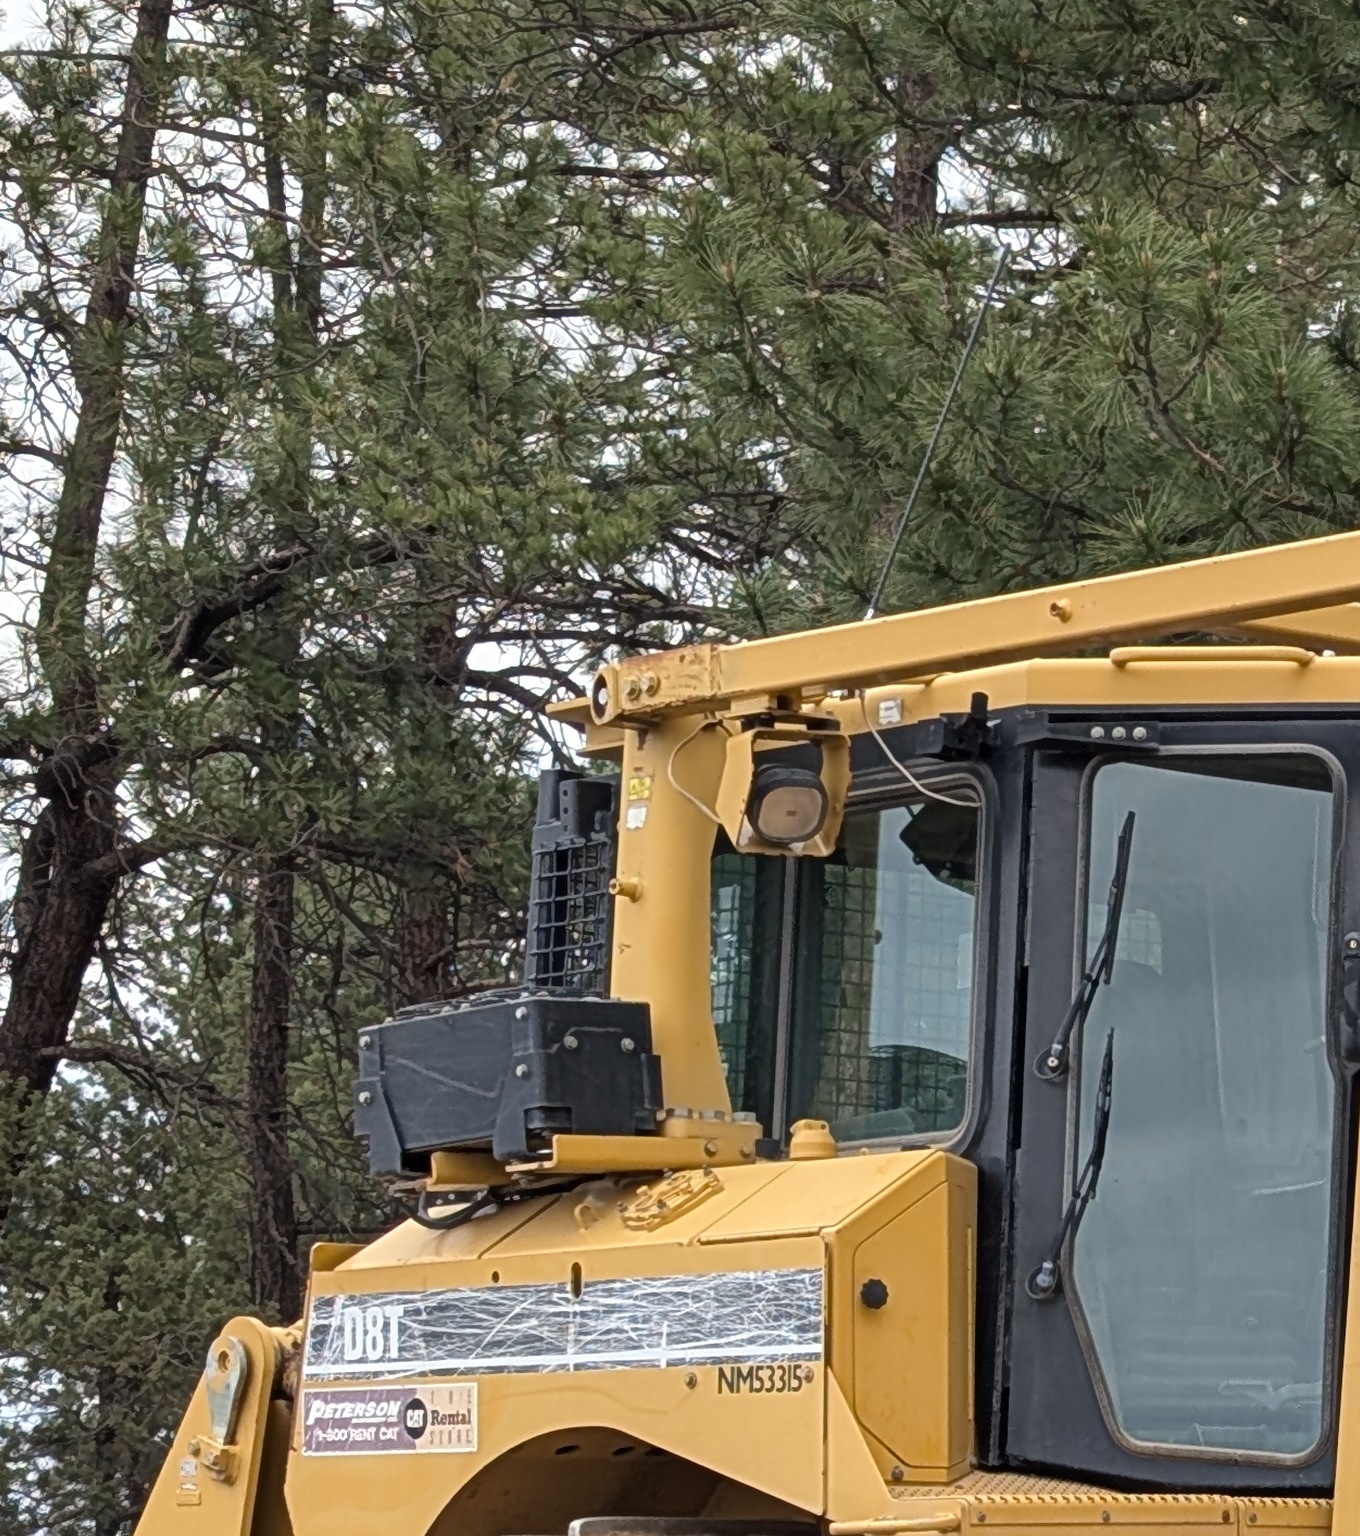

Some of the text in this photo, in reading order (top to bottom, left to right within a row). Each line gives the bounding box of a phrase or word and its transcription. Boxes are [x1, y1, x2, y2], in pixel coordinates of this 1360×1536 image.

[343, 1305, 405, 1361] D8T
[718, 1364, 803, 1394] NM53315
[305, 1398, 402, 1426] PETERSON
[406, 1409, 425, 1429] CAT
[430, 1407, 472, 1426] Rental
[349, 1426, 377, 1442] RENT
